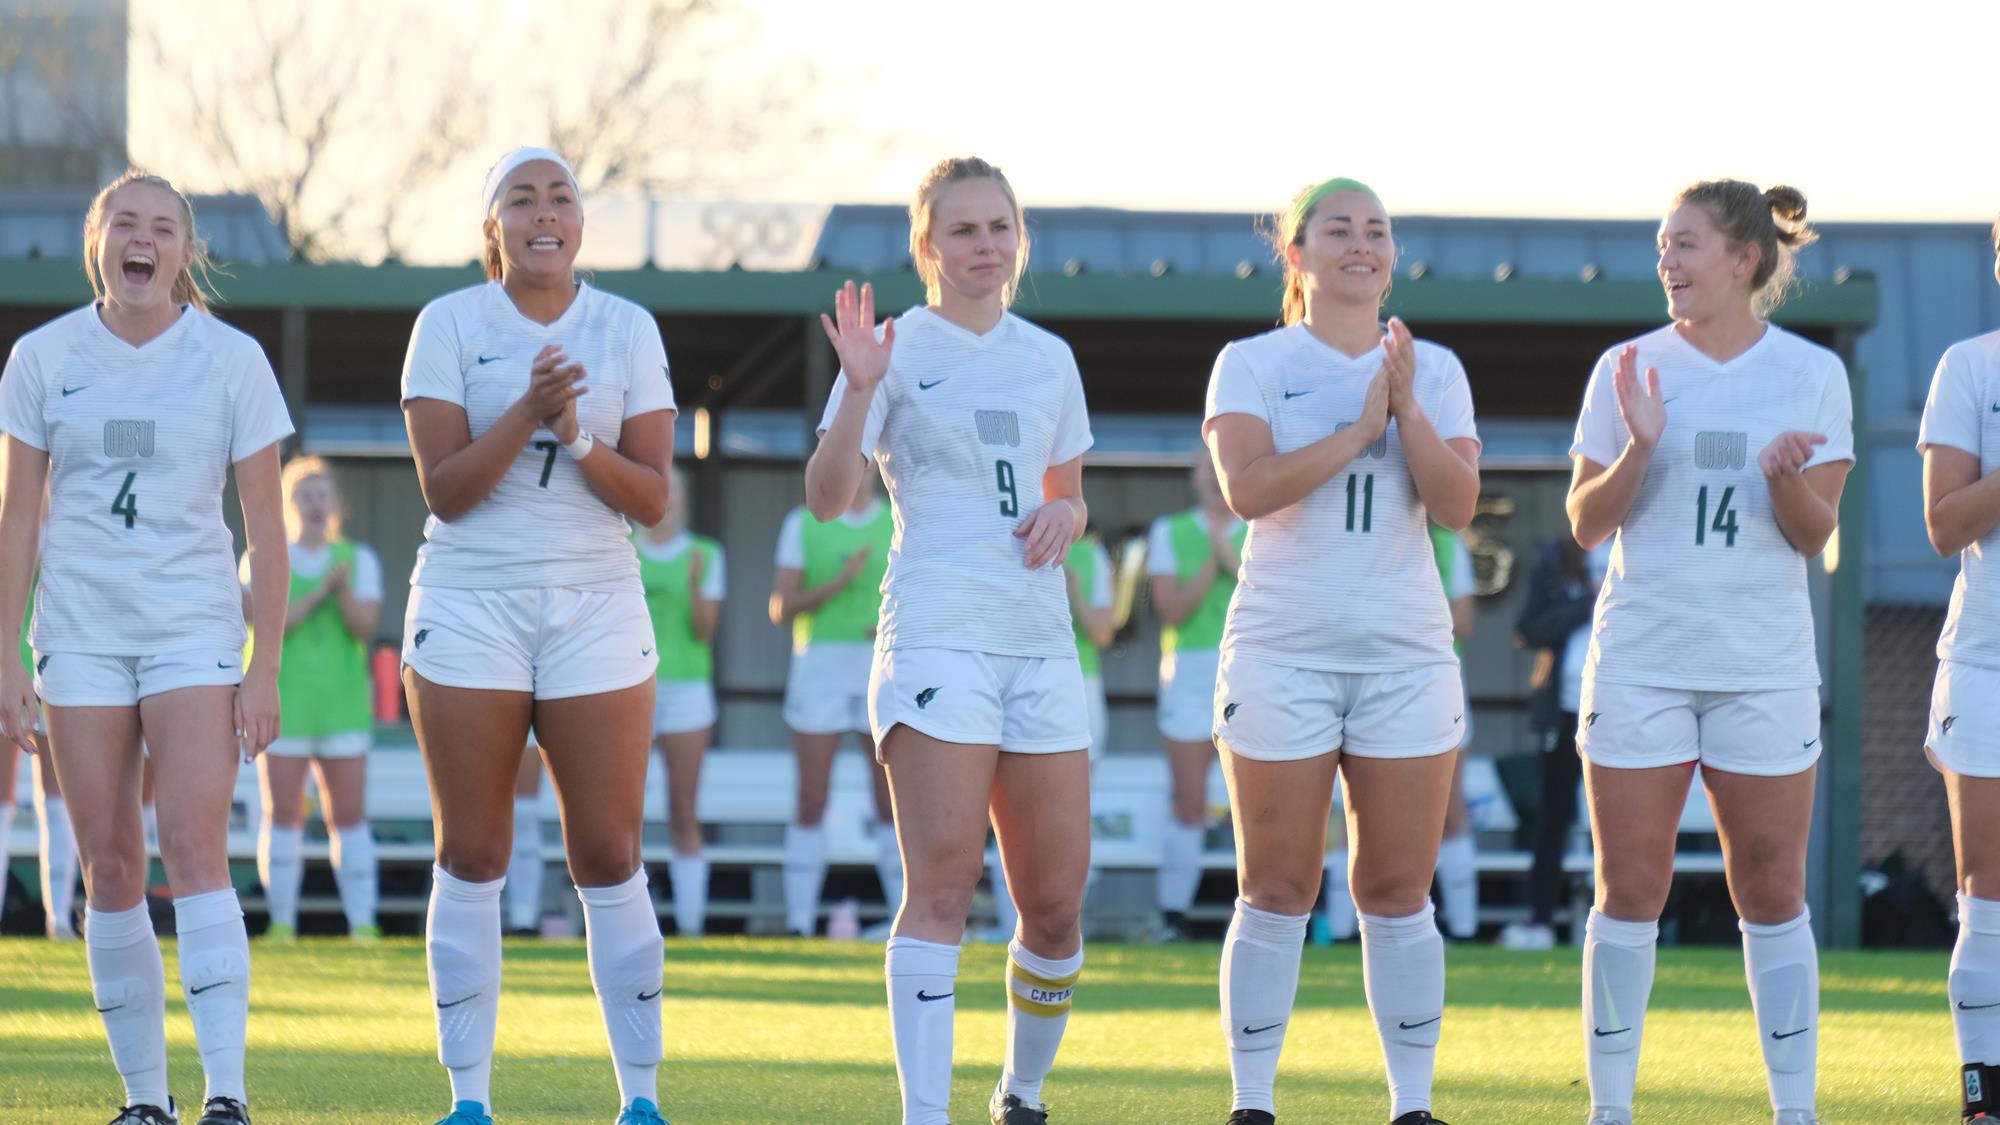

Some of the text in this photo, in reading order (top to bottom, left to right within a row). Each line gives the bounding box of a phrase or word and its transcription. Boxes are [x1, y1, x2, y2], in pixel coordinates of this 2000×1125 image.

[104, 420, 156, 458] OBU
[535, 441, 558, 489] 7
[1694, 431, 1748, 470] OBU
[111, 472, 138, 529] 4
[995, 459, 1018, 518] 9
[1345, 474, 1374, 533] 11
[1696, 486, 1739, 547] 14
[1031, 988, 1073, 1002] CAPTA
